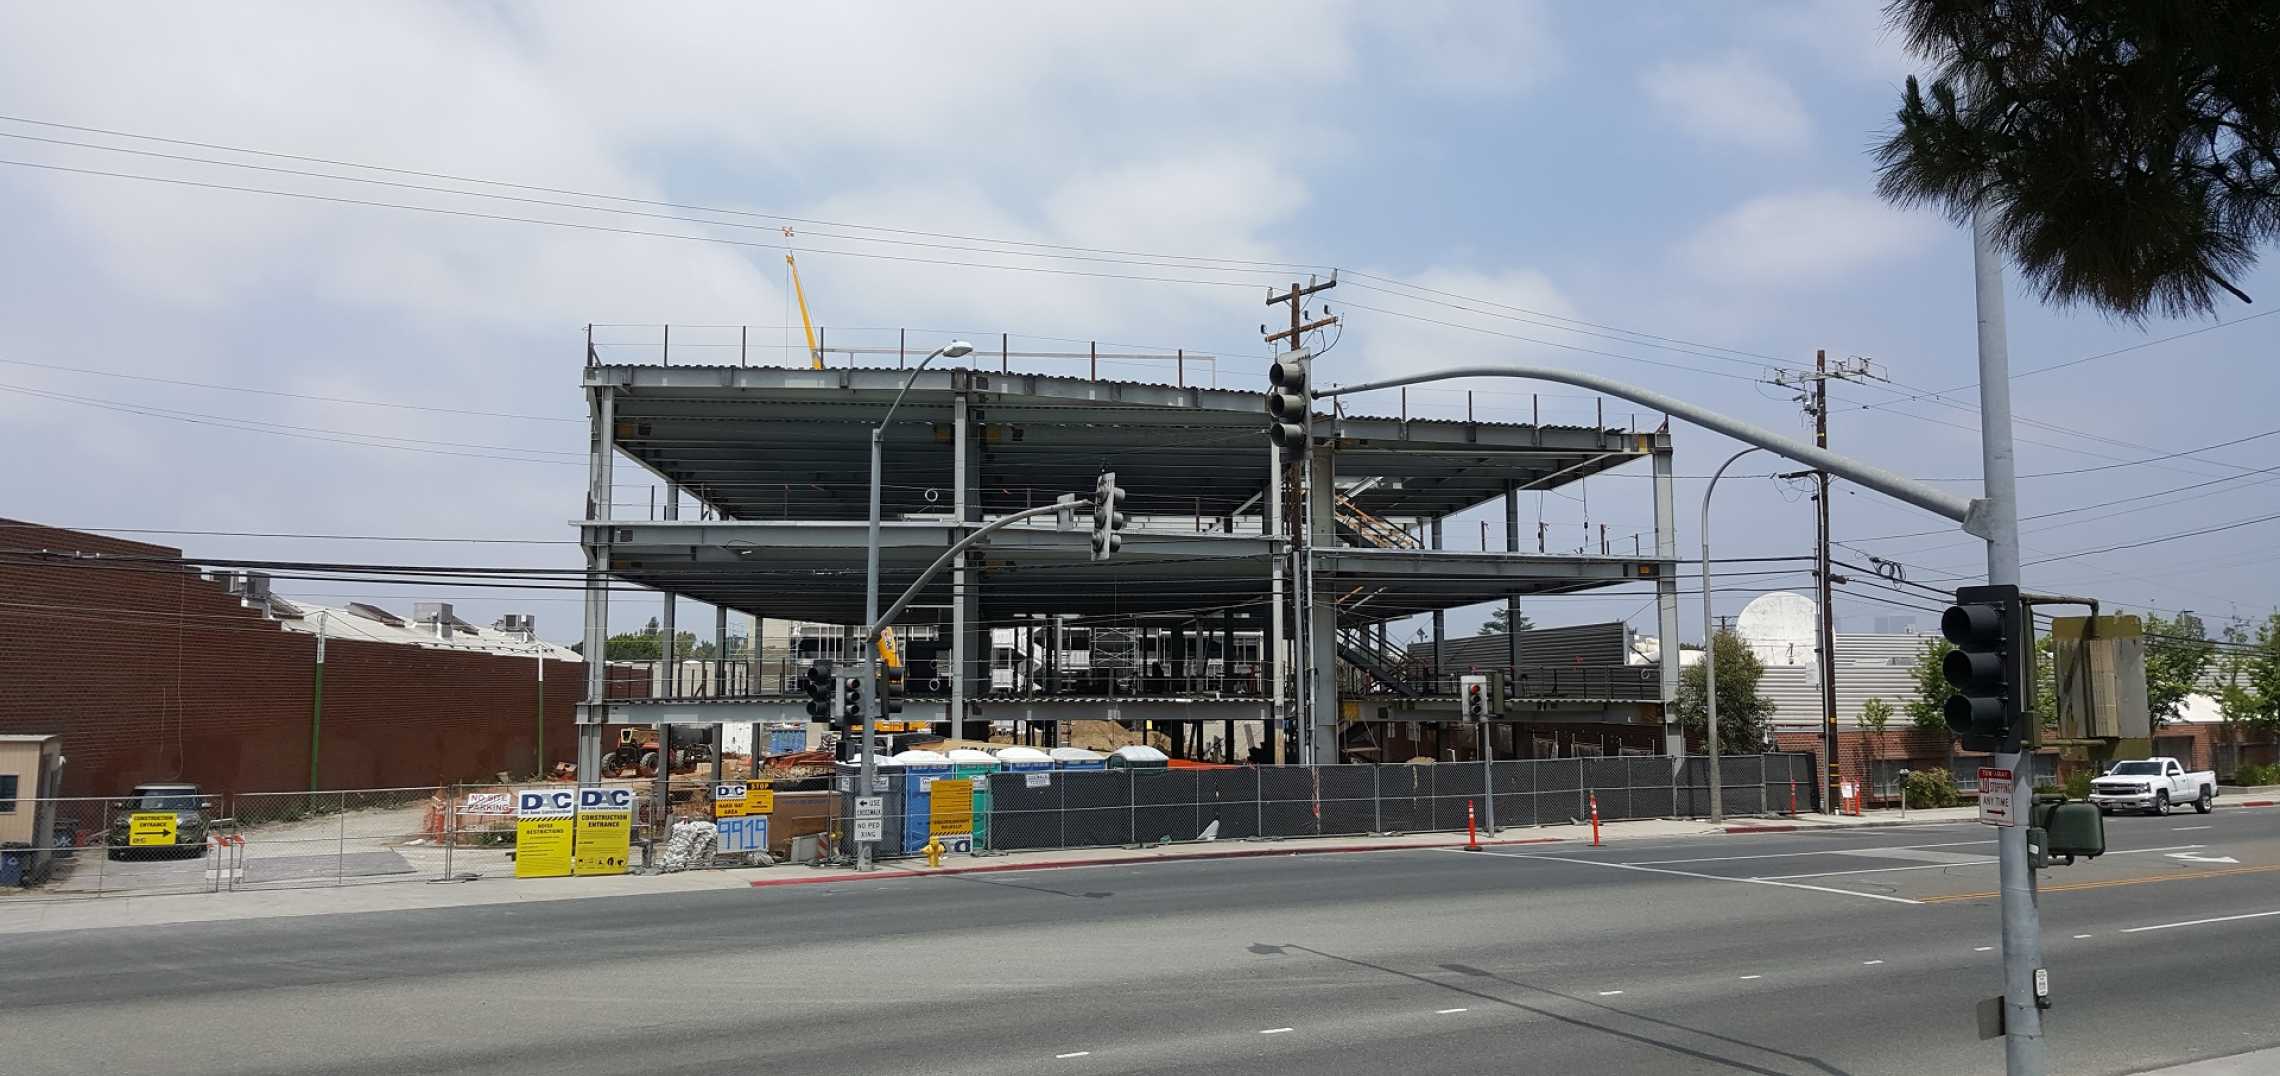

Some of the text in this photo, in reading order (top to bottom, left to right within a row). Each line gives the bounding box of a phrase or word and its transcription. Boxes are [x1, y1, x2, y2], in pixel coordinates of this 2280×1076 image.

[1990, 781, 2013, 793] STOPPING
[521, 792, 572, 810] DAC
[581, 790, 629, 806] DAC
[869, 799, 881, 807] USE
[1983, 796, 2009, 807] ANY TIME
[856, 809, 881, 817] CROSSWALK
[718, 819, 767, 850] 9919
